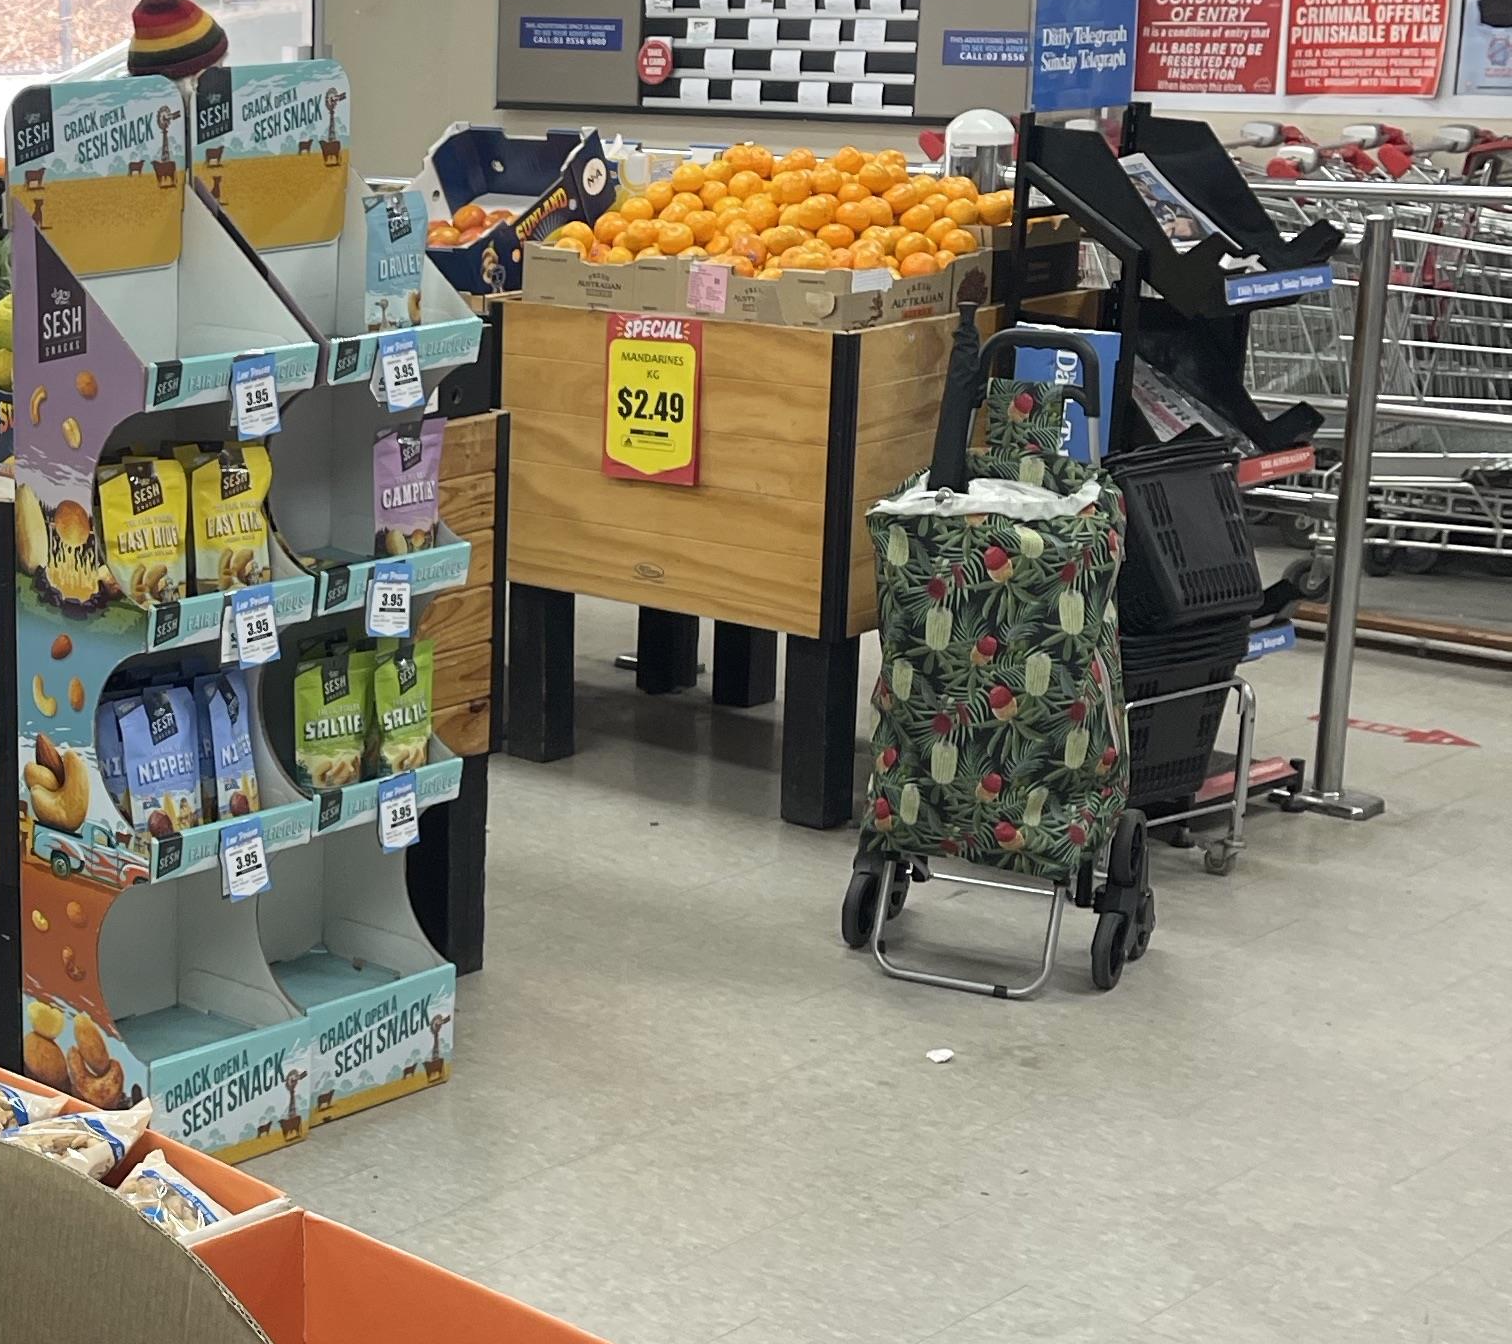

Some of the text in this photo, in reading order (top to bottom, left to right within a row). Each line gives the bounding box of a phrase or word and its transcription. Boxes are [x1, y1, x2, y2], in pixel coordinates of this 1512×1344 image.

[1171, 7, 1250, 22] OF ENTRY
[1296, 4, 1440, 25] CRIMINAL OFFENCE
[1042, 25, 1127, 48] Daily Telegraph
[1168, 27, 1210, 37] condition
[1213, 27, 1222, 37] of
[1224, 29, 1249, 40] entry
[1251, 28, 1270, 38] that
[1291, 24, 1443, 44] PUNISHABLE BY LAW
[1041, 48, 1126, 73] Sunday Telegraph
[1148, 43, 1263, 56] ALL BAGS ARE TO BE
[1160, 56, 1247, 68] PRESENTED FOR
[1168, 68, 1236, 80] INSPECTION
[242, 88, 298, 122] CRACK OPEN A
[64, 106, 127, 142] CRACK OPEN A
[253, 96, 323, 144] SESH SNACK
[17, 122, 51, 151] SESH
[77, 112, 155, 165] SESH SNACK
[515, 187, 568, 241] SUNLAND
[891, 290, 945, 311] AUSTRALIAN
[43, 306, 82, 340] SESH
[624, 320, 684, 340] SPECIAL
[621, 351, 684, 367] MANDARINES
[394, 363, 414, 379] 3.95
[646, 370, 660, 380] KG
[246, 389, 269, 406] 3.95
[617, 386, 684, 423] $2.49
[247, 619, 268, 636] 3.95
[320, 994, 398, 1054] CRACK OPEN A
[334, 993, 432, 1078] SESH SNACK
[164, 1049, 249, 1114] CRACK OPEN A
[182, 1048, 287, 1138] SESH SNACK
